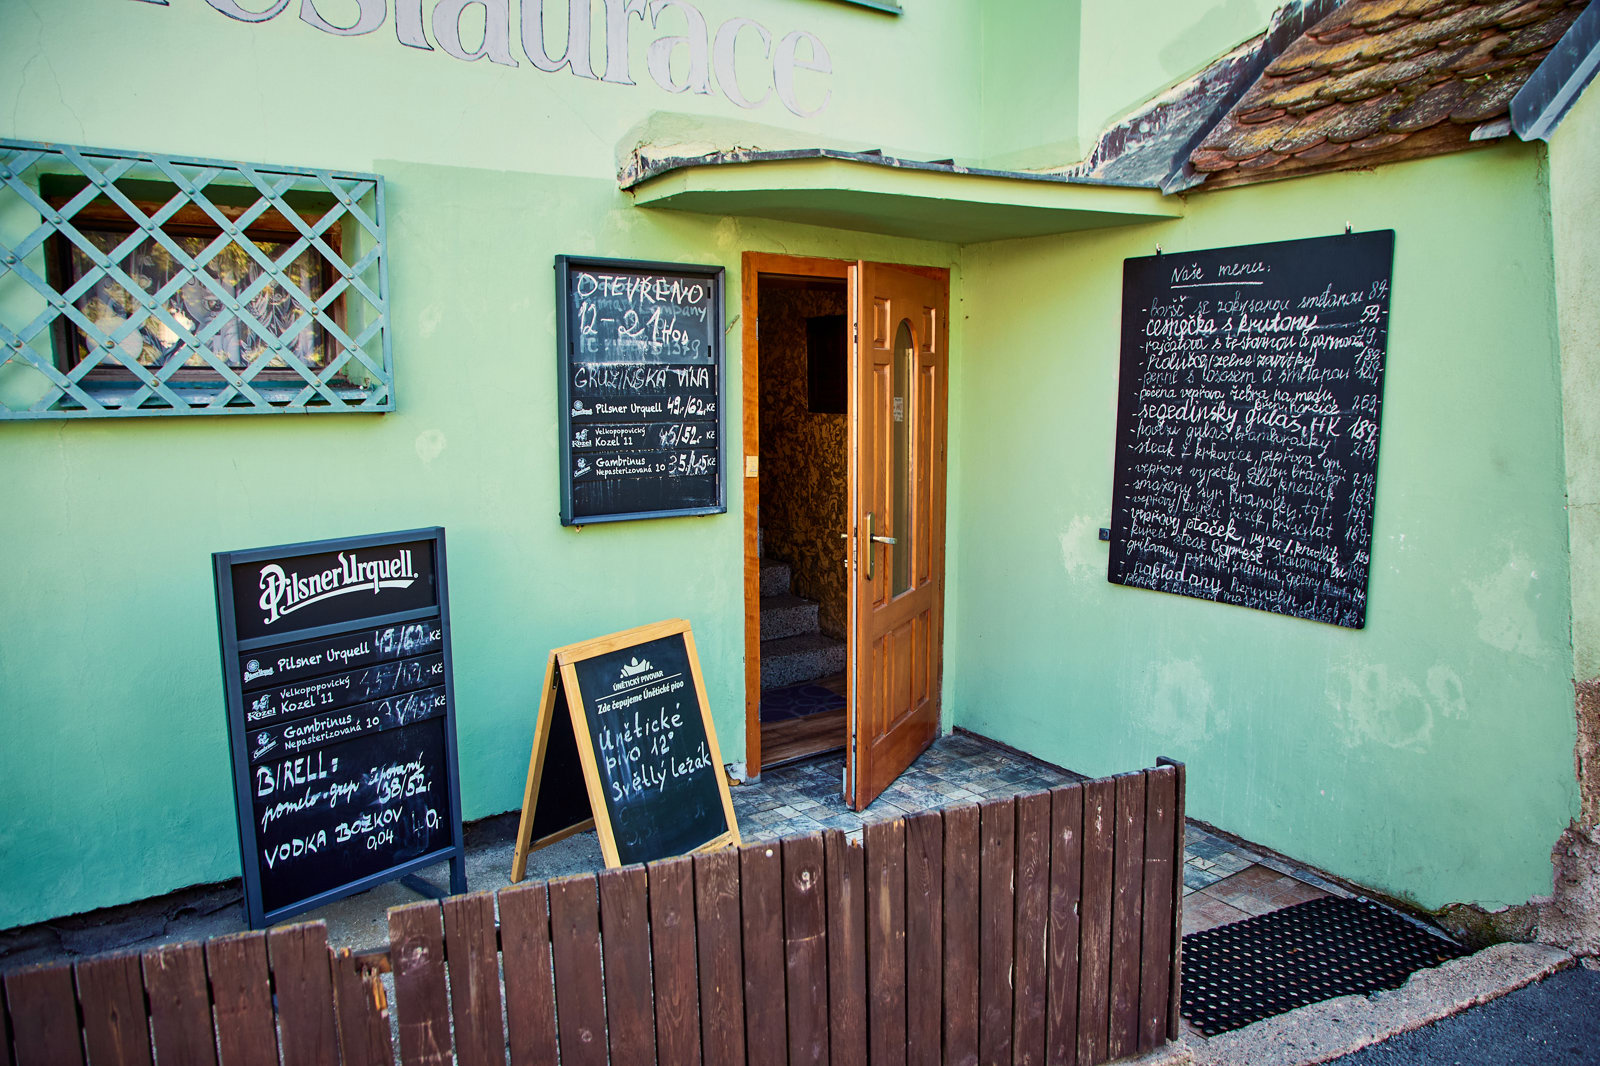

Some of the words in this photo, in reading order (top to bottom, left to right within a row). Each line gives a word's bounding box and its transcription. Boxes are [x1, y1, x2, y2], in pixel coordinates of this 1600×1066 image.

[1171, 262, 1205, 284] Naše
[1218, 261, 1271, 278] menu:
[577, 273, 704, 304] OTEVŘENO
[1221, 317, 1234, 332] s
[1237, 312, 1319, 337] krutony
[1211, 337, 1223, 351] s
[596, 403, 628, 415] Pilsner
[631, 403, 663, 418] Urquell
[706, 402, 716, 412] Kč
[595, 427, 646, 438] Velkopopovický
[595, 437, 621, 447] Kozel
[623, 437, 633, 446] 11
[706, 431, 716, 440] Kč
[595, 455, 646, 468] Gambrinus
[596, 464, 653, 479] Nepasterizovaná
[655, 463, 667, 472] 10
[260, 564, 342, 625] Pilsner
[278, 651, 322, 672] Pilsner
[325, 641, 370, 664] Urquell
[428, 628, 442, 641] Kč
[280, 675, 351, 699] Velkopopovický
[612, 676, 640, 692] ÚNĚTICKÝ
[639, 670, 664, 684] PIVOVAR
[247, 706, 276, 722] Kozel
[280, 695, 316, 715] Kozel
[320, 692, 340, 706] 11
[597, 704, 611, 714] Zde
[611, 694, 642, 711] čepujeme
[642, 682, 671, 700] Únětické
[670, 680, 684, 692] pivo
[283, 714, 352, 739] Gambrinus
[285, 719, 362, 752] Nepasterizovaná
[365, 715, 381, 730] 10
[599, 702, 684, 750] Únětické
[606, 746, 641, 776] pivo
[612, 760, 667, 802] Světlý
[671, 740, 712, 778] ležák
[264, 829, 327, 870] VODKA
[333, 806, 403, 843] BOŽKOV
[366, 829, 395, 851] 0,04
